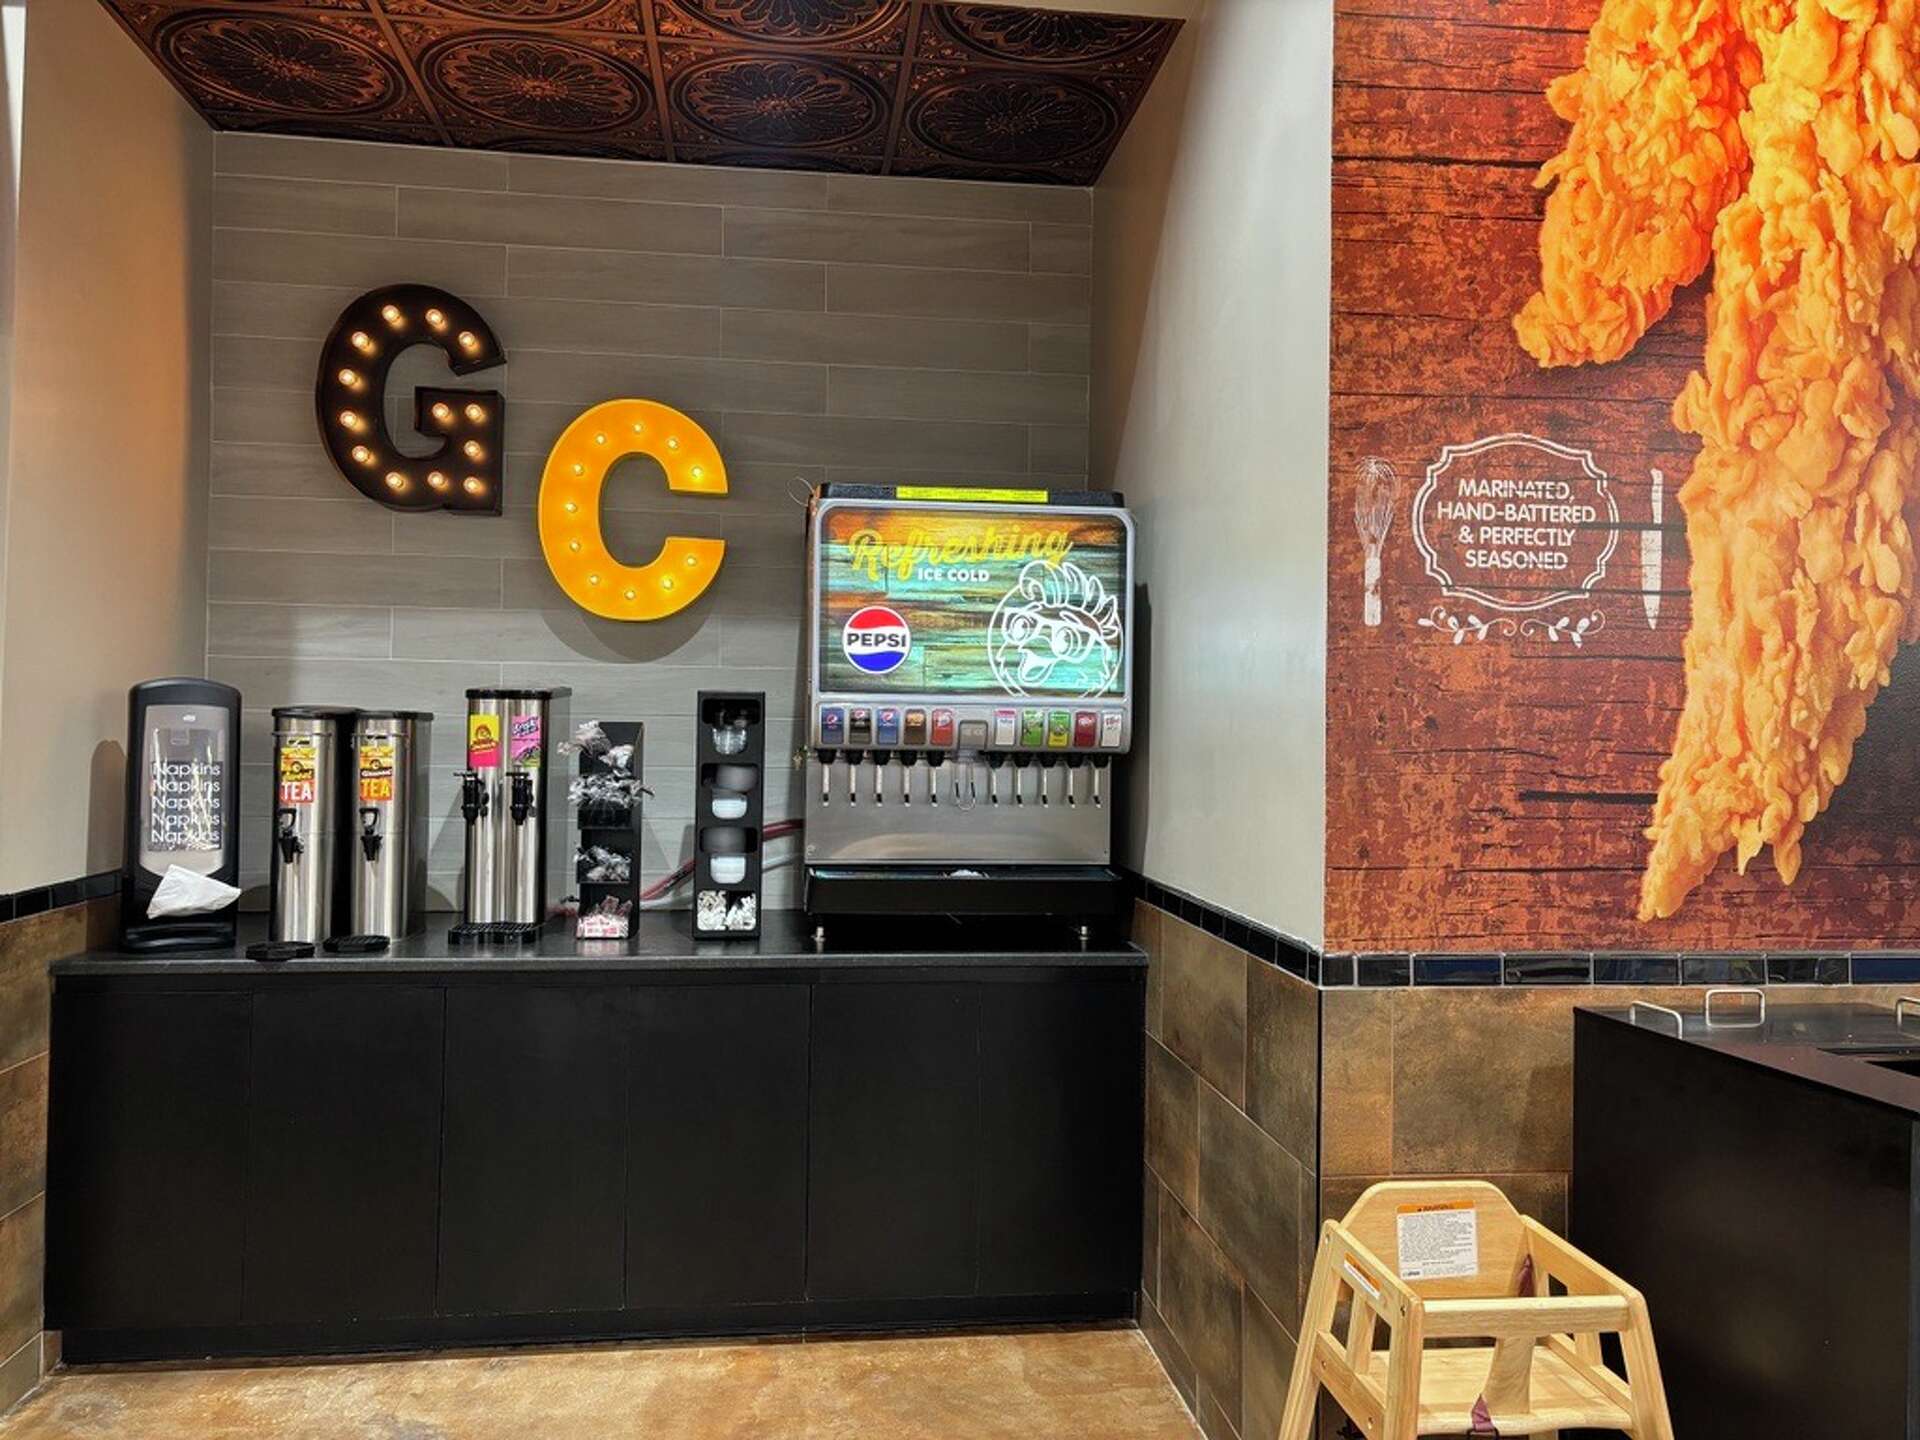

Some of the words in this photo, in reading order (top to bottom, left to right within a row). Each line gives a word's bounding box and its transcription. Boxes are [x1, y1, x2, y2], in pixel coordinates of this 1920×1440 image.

[315, 283, 507, 516] G
[1457, 478, 1575, 502] MARINATED,
[538, 398, 729, 622] C
[1437, 502, 1597, 523] HAND-BATTERED
[1457, 525, 1473, 545] &
[1479, 527, 1576, 547] PERFECTLY
[849, 525, 1074, 582] Refreshing
[1465, 550, 1569, 570] SEASONED
[917, 567, 943, 581] ICE
[947, 568, 990, 582] COLD
[846, 632, 907, 649] PEPSI
[281, 781, 312, 801] TEA
[360, 778, 391, 797] TEA
